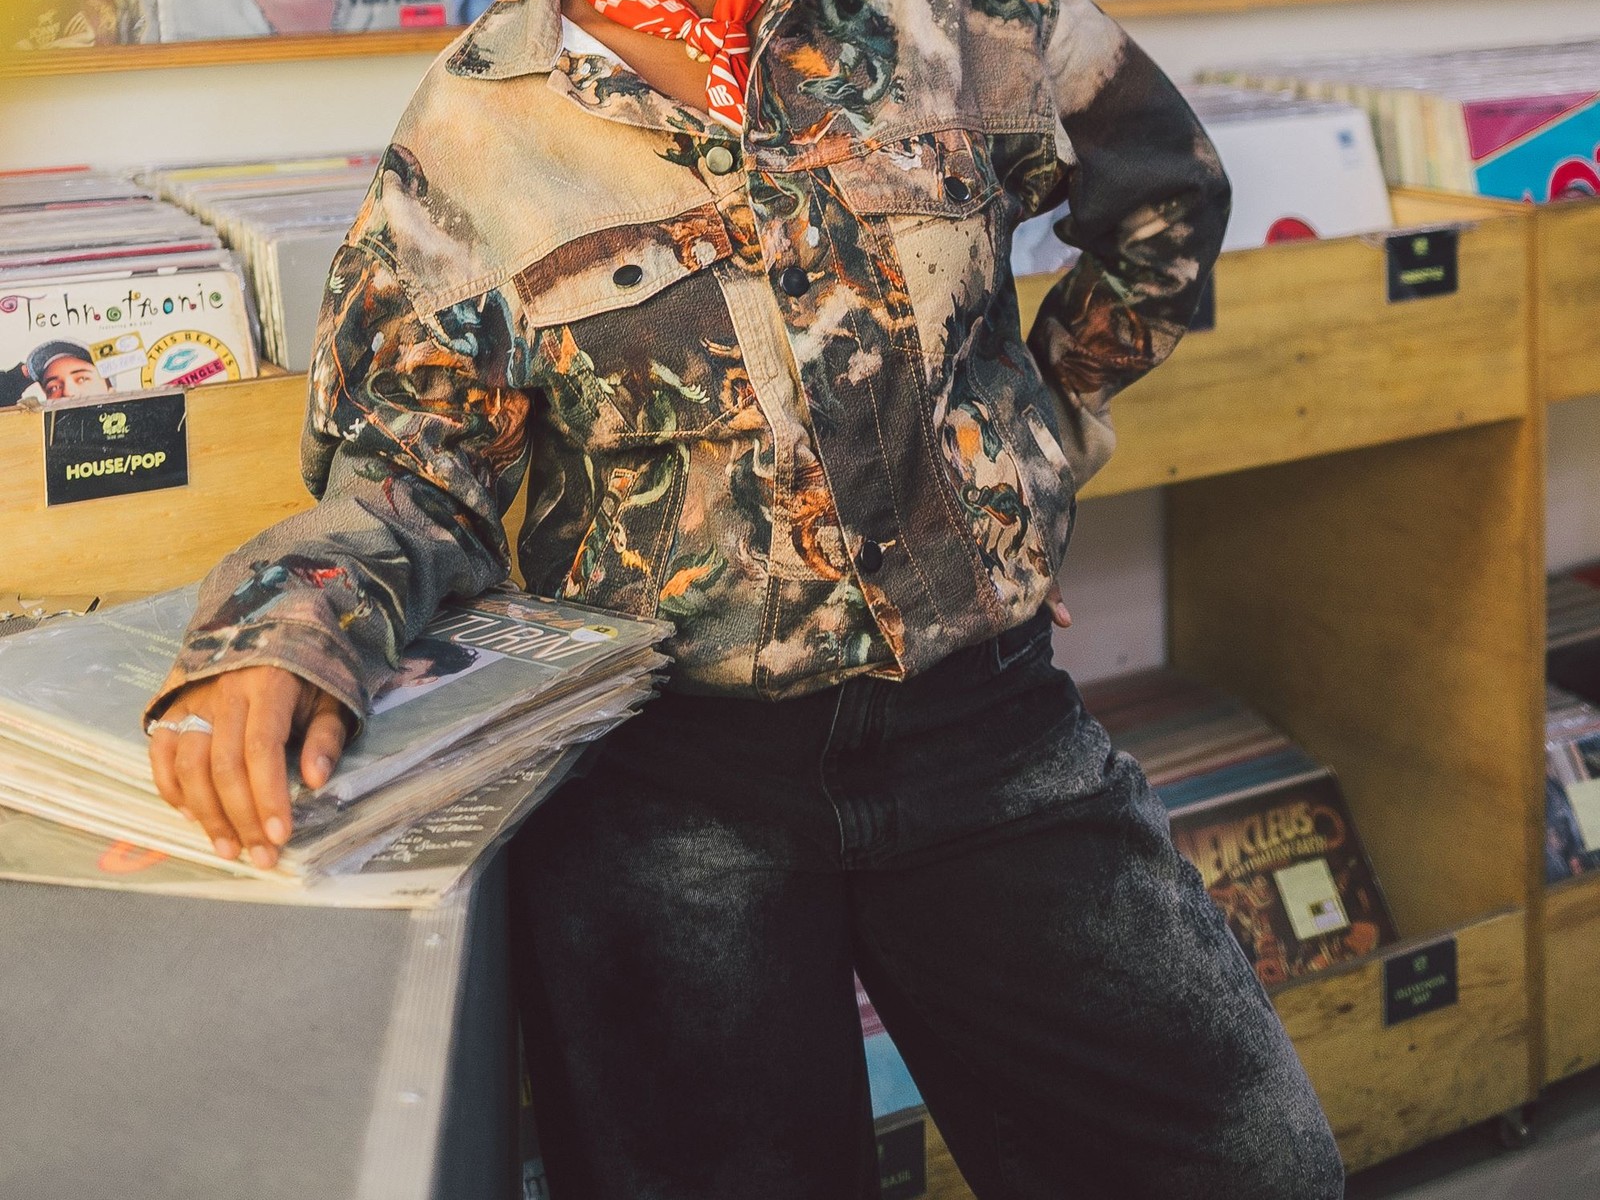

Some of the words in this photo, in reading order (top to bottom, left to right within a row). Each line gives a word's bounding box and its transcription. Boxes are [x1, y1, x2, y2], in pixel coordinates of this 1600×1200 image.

[0, 283, 224, 331] Technotronic
[149, 334, 178, 362] THIS
[184, 332, 222, 352] BEAT
[177, 359, 224, 385] SINGLE
[66, 451, 166, 481] HOUSE/POP
